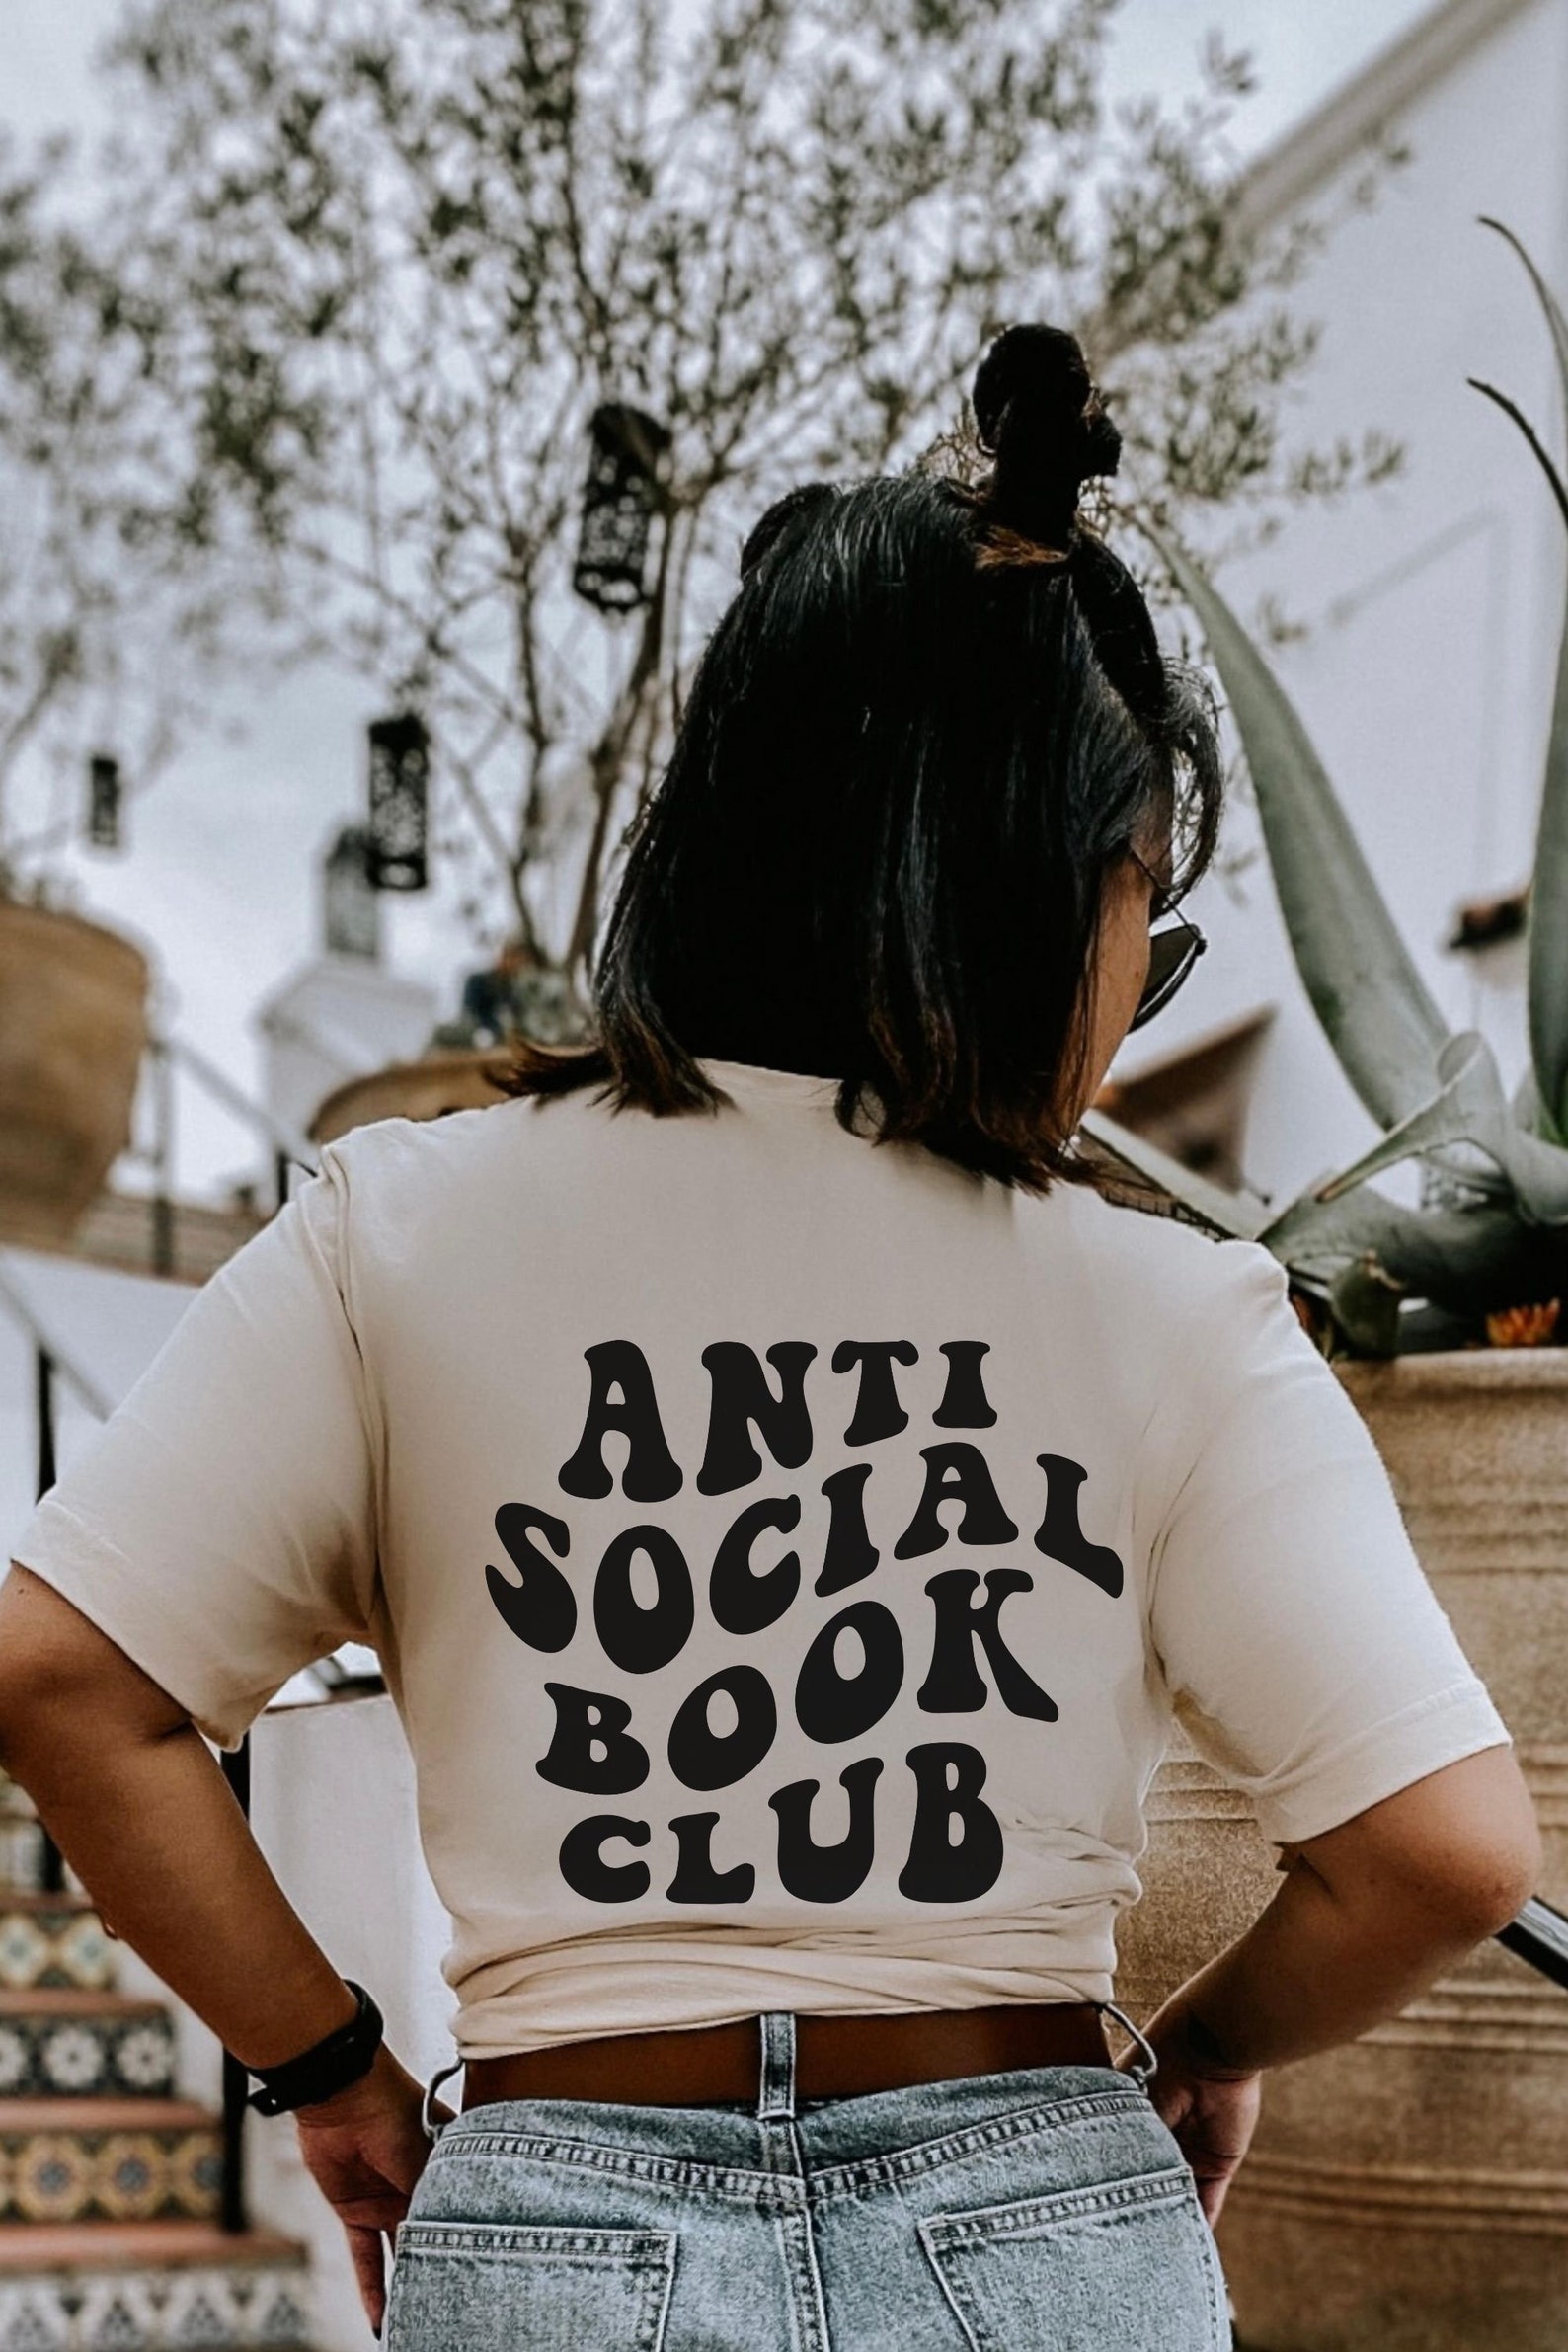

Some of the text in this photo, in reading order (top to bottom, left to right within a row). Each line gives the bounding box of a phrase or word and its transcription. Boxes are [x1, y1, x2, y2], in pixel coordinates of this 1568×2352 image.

[558, 1340, 997, 1503] ANTI
[485, 1442, 1123, 1674] SOCIAL
[536, 1569, 1058, 1795] BOOK
[559, 1743, 1003, 1904] CLUB
